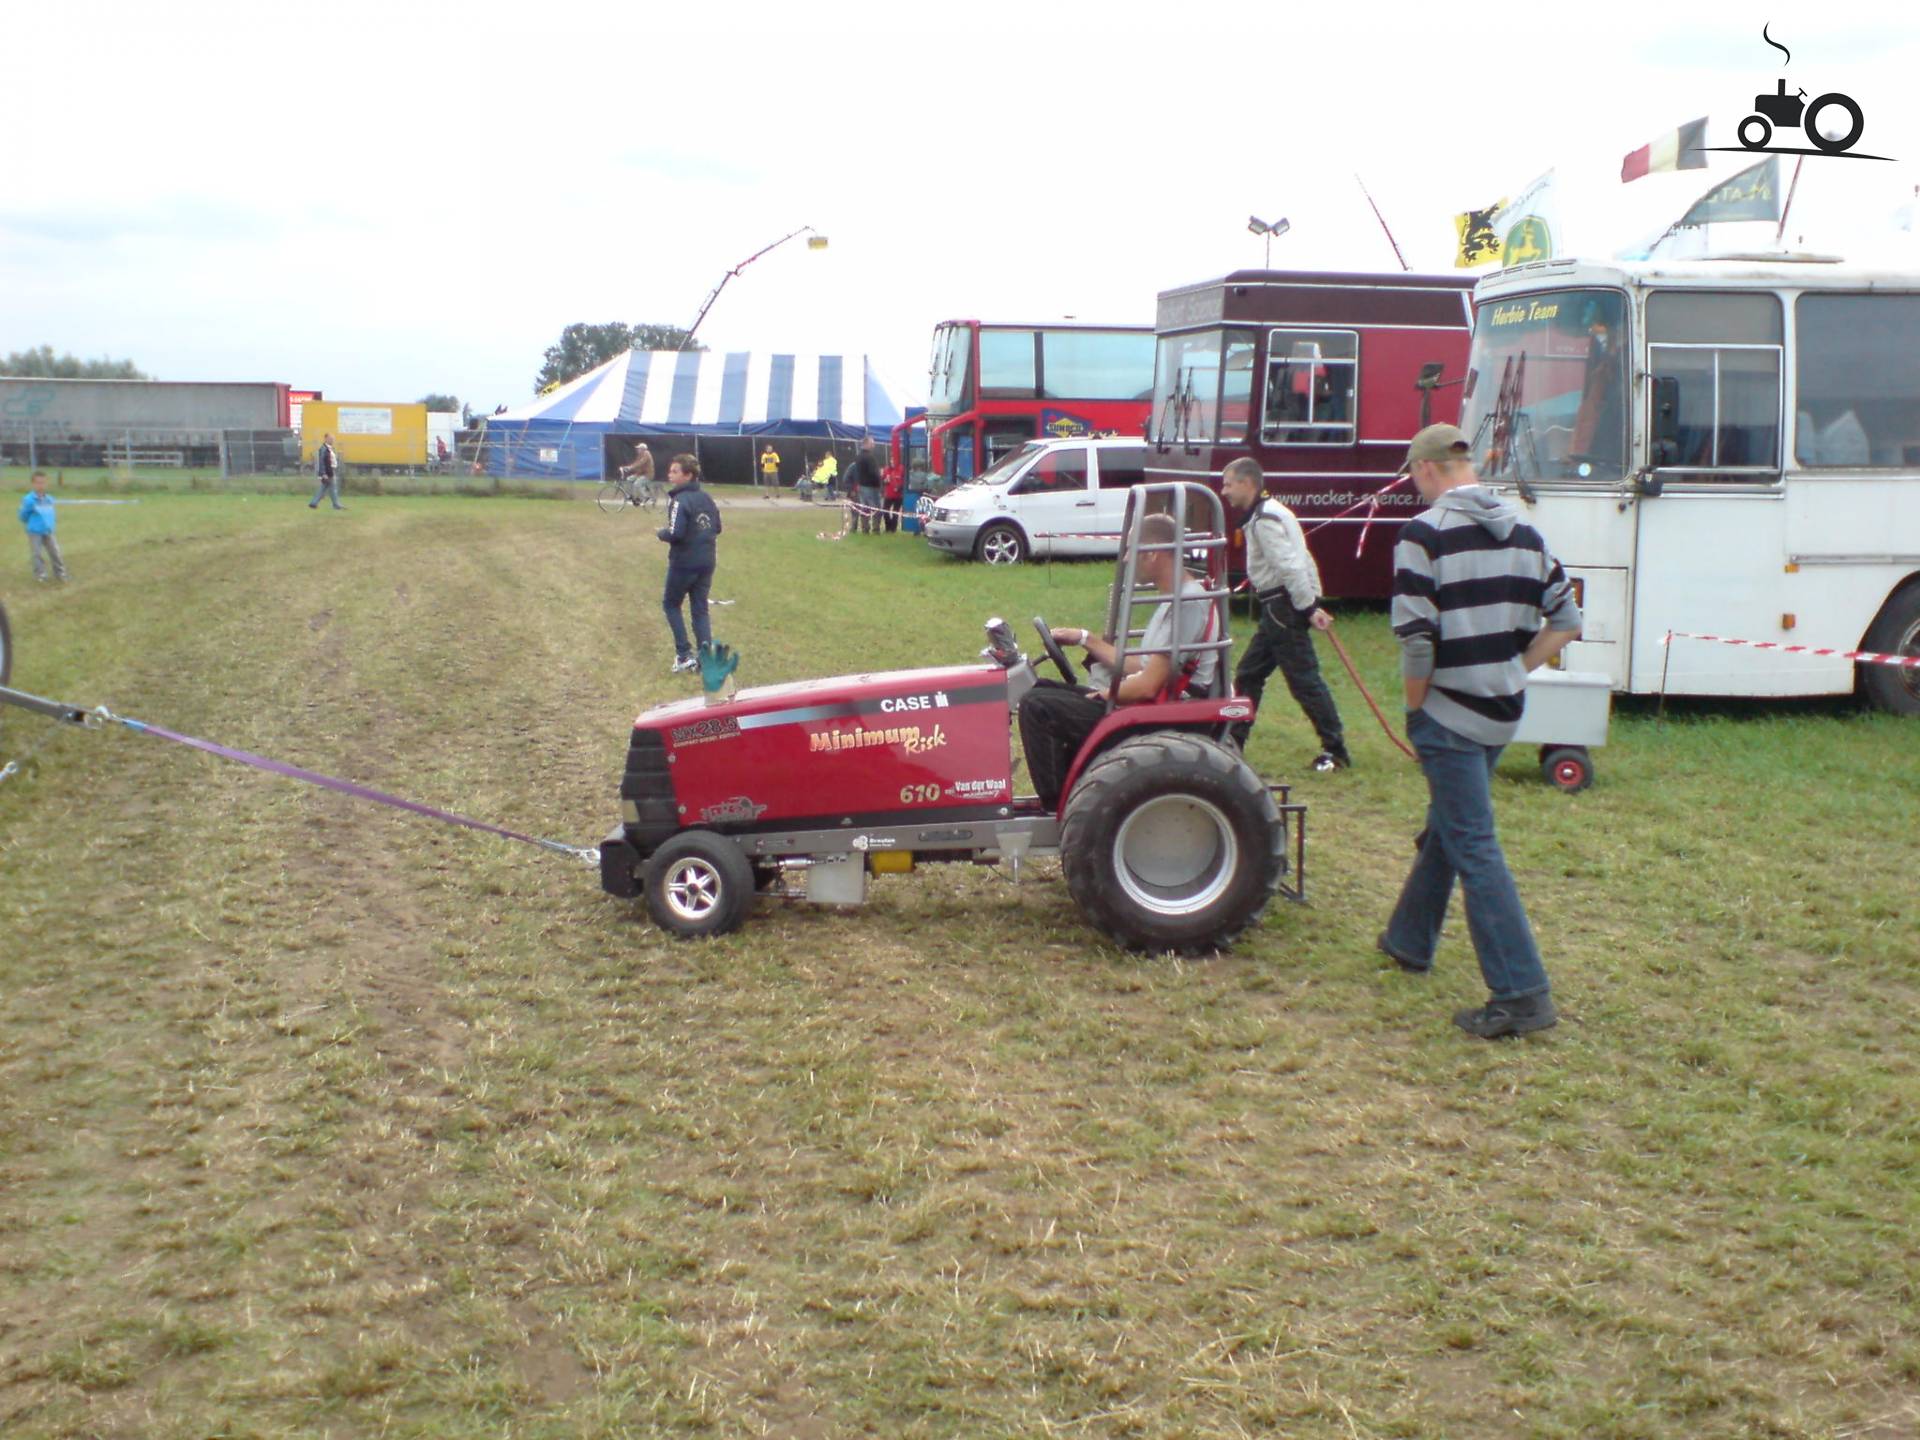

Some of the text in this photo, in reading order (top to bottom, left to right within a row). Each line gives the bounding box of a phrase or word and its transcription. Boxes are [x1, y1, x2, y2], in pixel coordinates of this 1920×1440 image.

[1528, 301, 1559, 320] Team
[880, 696, 931, 713] CASE
[810, 726, 920, 752] Minimum
[903, 723, 947, 756] Risk
[900, 783, 941, 804] 610
[955, 781, 971, 792] Van
[971, 780, 985, 791] der
[985, 778, 1006, 790] Waal
